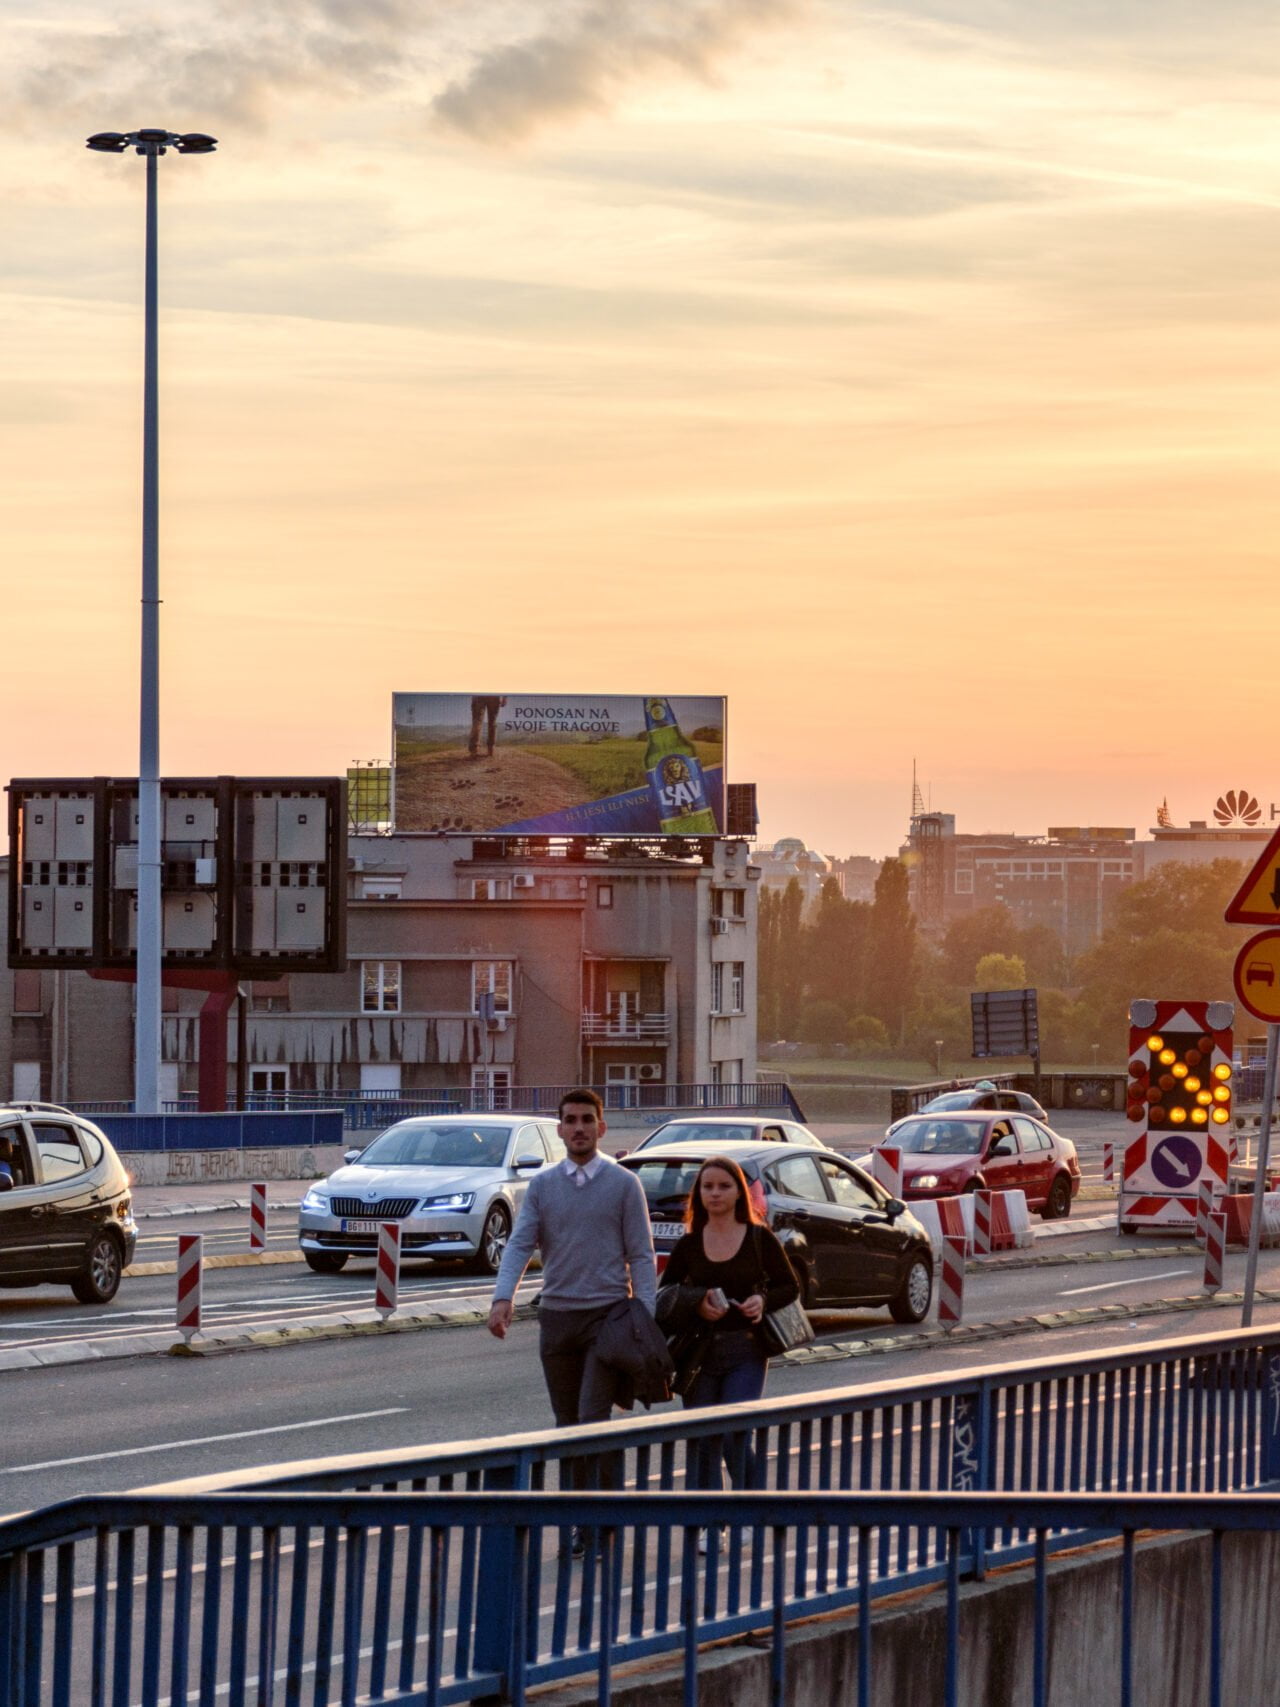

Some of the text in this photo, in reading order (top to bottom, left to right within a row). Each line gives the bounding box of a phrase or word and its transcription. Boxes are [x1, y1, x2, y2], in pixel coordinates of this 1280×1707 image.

[515, 707, 610, 719] PONOSAN NA
[504, 720, 620, 733] SVOJE TRAGOVE
